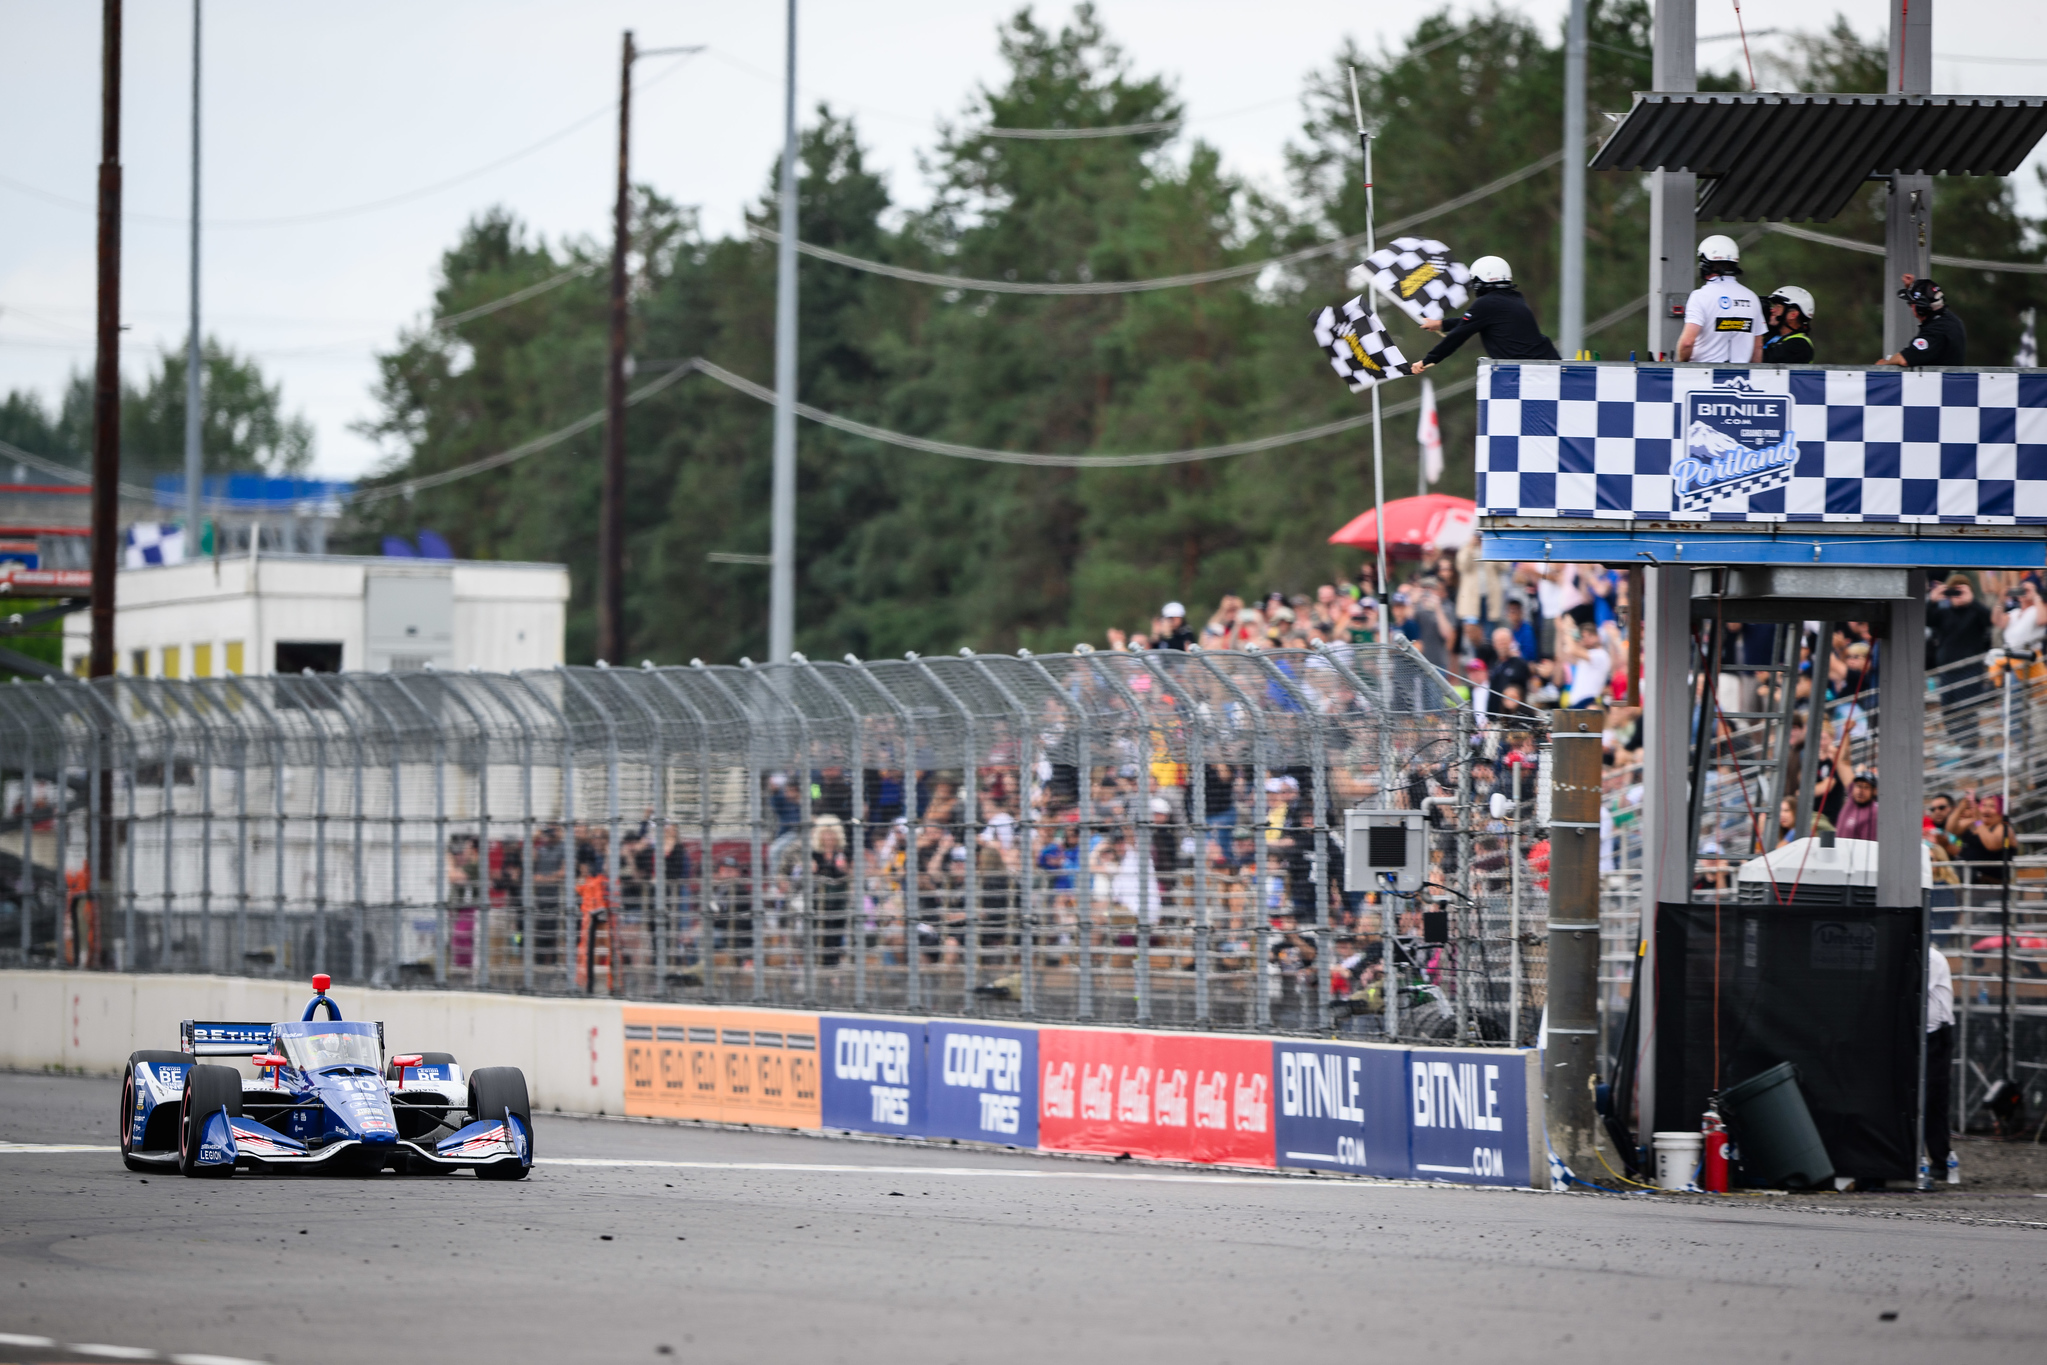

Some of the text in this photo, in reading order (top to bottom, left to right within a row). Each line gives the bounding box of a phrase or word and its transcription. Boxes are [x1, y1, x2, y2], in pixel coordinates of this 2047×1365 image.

[1697, 403, 1779, 417] BITNILE
[1674, 431, 1794, 493] Portland
[159, 1071, 182, 1083] BE
[338, 1081, 378, 1091] 10
[834, 1027, 911, 1086] COOPER
[942, 1032, 1023, 1093] COOPER
[1281, 1051, 1365, 1123] BITNILE
[1412, 1061, 1503, 1132] BITNILE
[200, 1150, 222, 1160] LEGION
